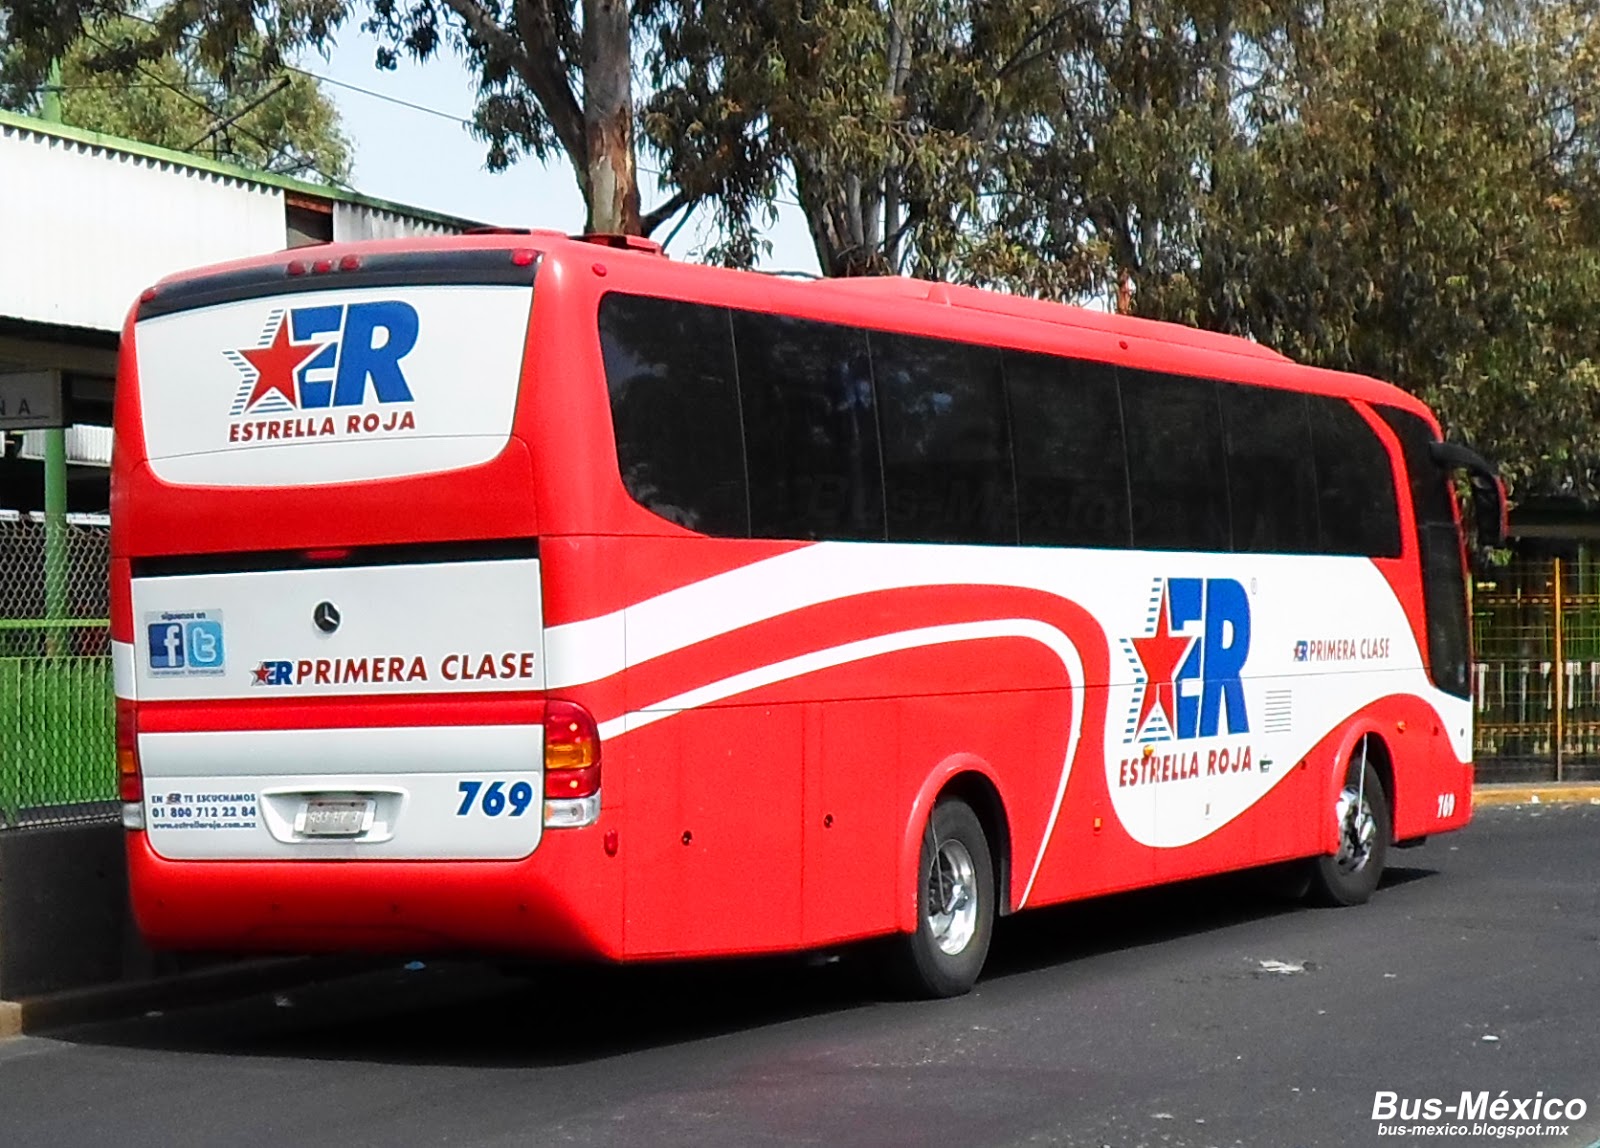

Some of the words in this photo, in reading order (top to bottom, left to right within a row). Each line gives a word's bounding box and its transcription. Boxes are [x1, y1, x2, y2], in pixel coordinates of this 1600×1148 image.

[229, 417, 335, 442] ESTRELLA
[346, 411, 415, 433] ROJA
[1310, 639, 1356, 661] PRIMERA
[1361, 638, 1390, 659] CLASE
[296, 656, 428, 685] PRIMERA
[441, 653, 534, 680] CLASE
[1119, 751, 1199, 787] ESTRELLA
[1207, 745, 1251, 775] ROJA
[151, 795, 163, 803] EN
[184, 795, 194, 803] TE
[196, 794, 256, 803] ESCUCHAMOS
[152, 807, 165, 817] 01
[170, 807, 192, 817] 800
[196, 806, 218, 817] 712
[222, 806, 237, 817] 22
[241, 806, 256, 817] 84
[457, 782, 533, 817] 769
